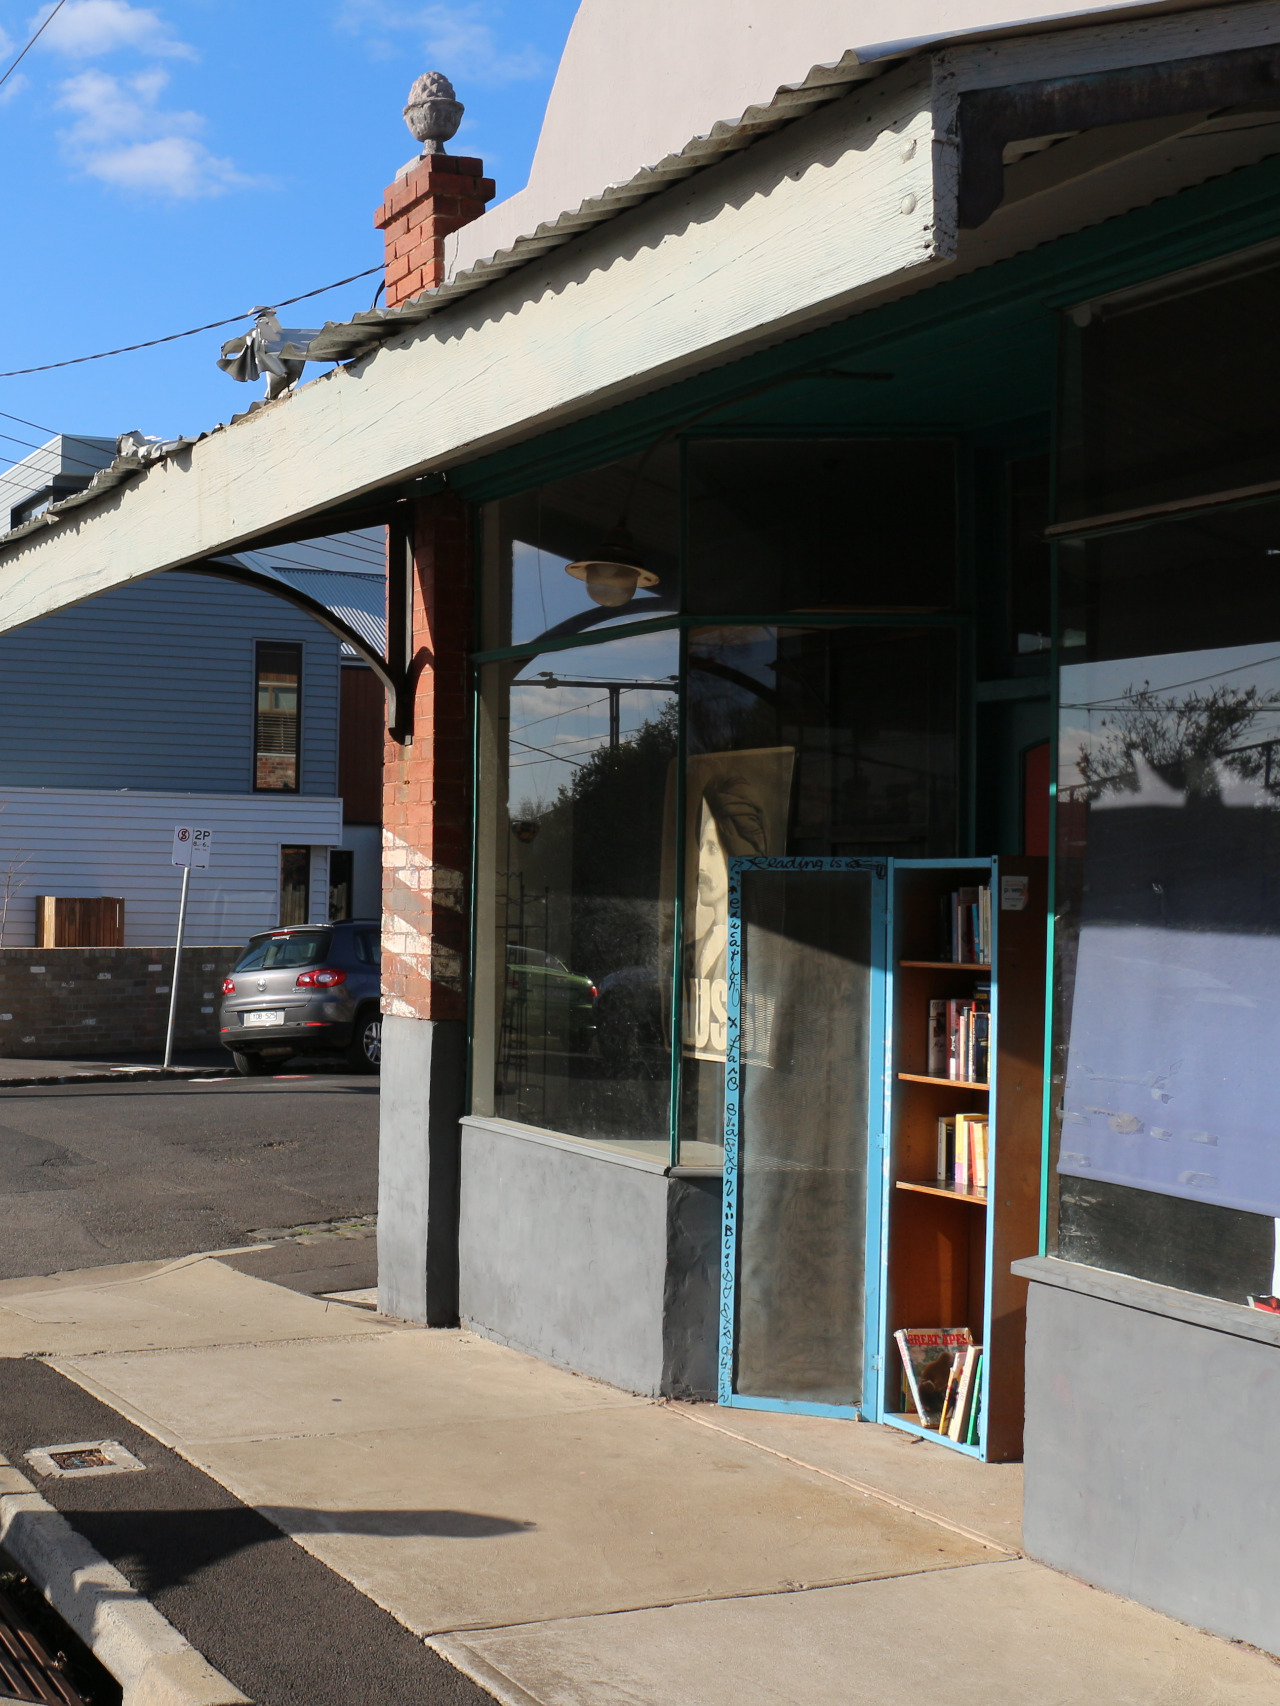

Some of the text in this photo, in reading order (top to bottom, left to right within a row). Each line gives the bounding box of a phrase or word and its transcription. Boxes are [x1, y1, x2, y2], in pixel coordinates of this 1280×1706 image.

[195, 830, 210, 840] 2P
[907, 1334, 969, 1346] GREAT APES
